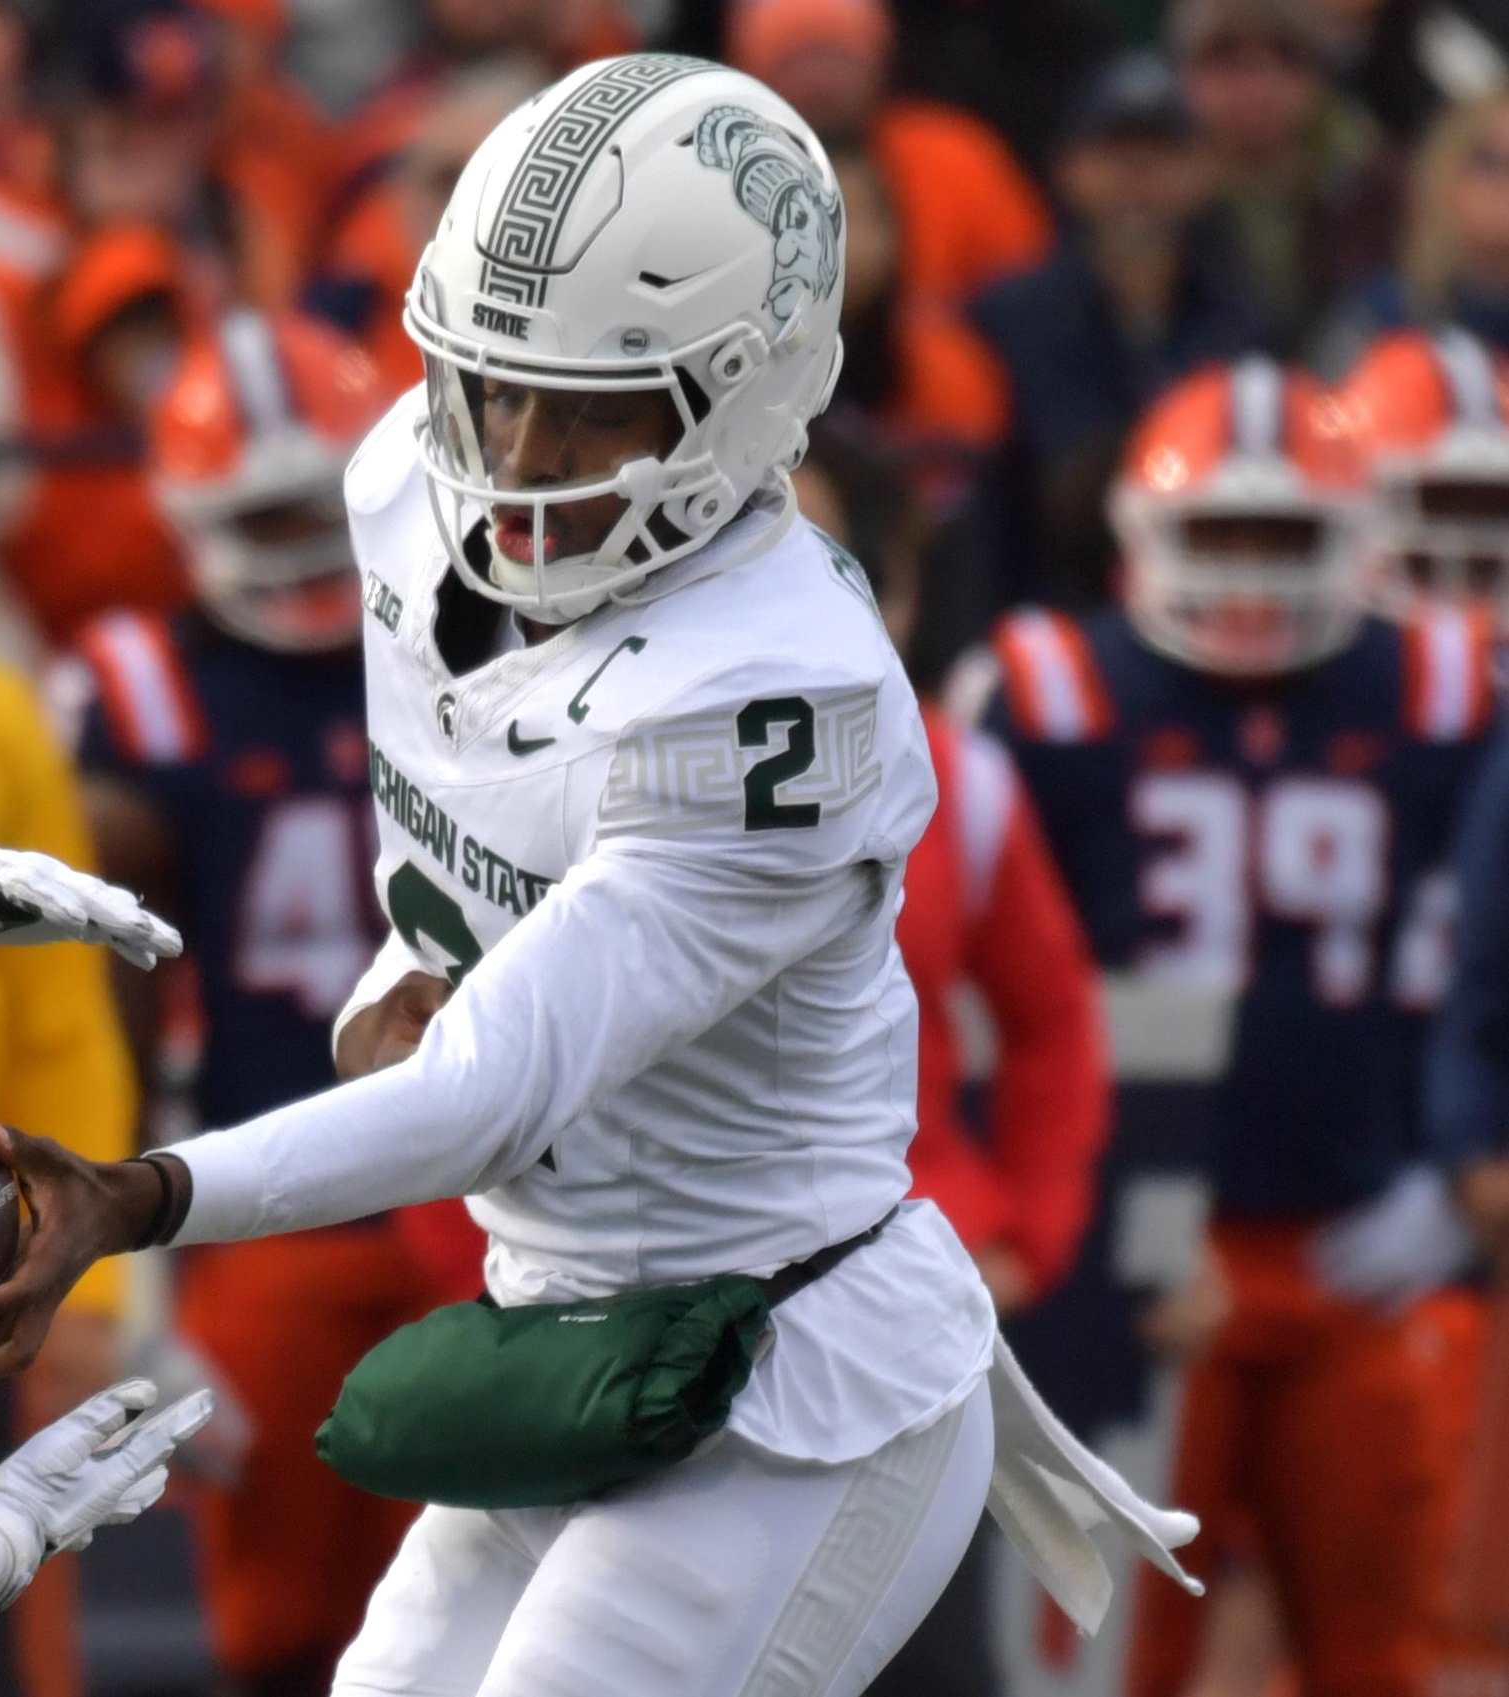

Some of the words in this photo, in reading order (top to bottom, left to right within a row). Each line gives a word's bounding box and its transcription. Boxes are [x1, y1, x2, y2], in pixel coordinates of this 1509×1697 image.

[472, 302, 532, 341] STATE
[567, 635, 647, 725] C
[369, 740, 457, 876] ICHIGAN
[736, 696, 820, 831] 2
[232, 798, 378, 1015] 4
[1128, 768, 1391, 1005] 39
